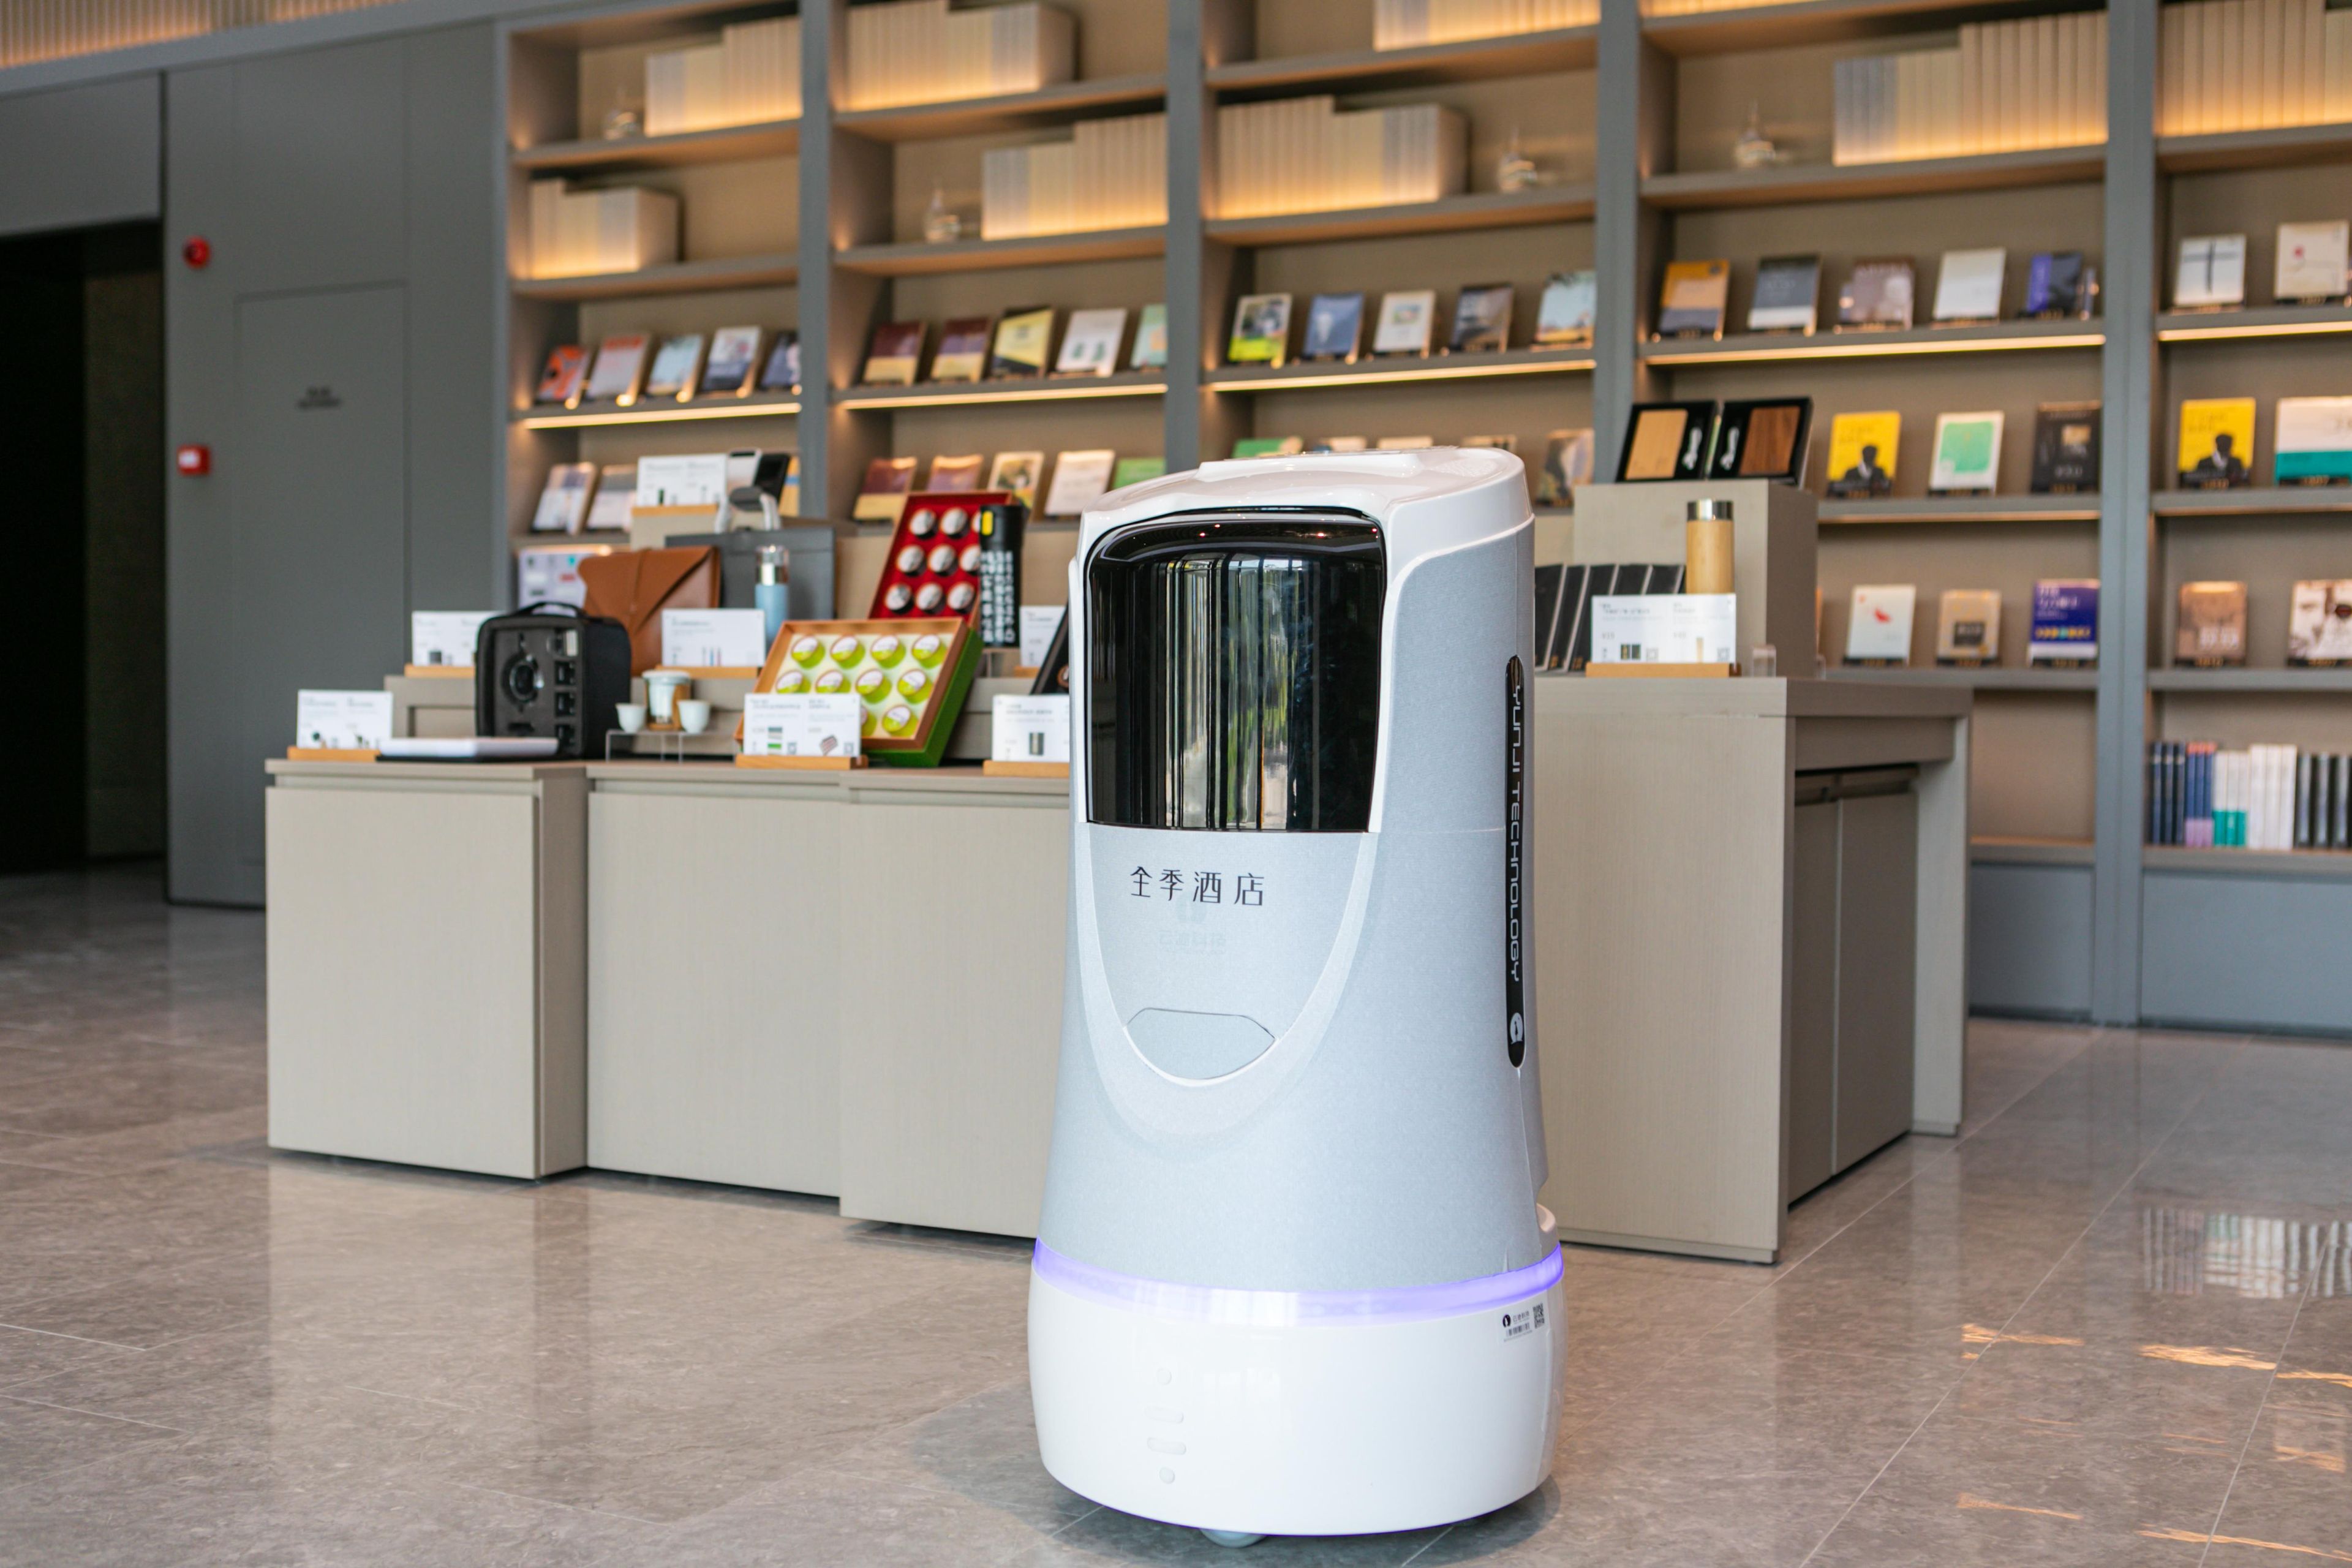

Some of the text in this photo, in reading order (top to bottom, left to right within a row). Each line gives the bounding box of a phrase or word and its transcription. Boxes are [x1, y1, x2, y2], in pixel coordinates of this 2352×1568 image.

[1131, 866, 1264, 905] 全季酒店
[1510, 782, 1520, 981] TECHNOLOGY
